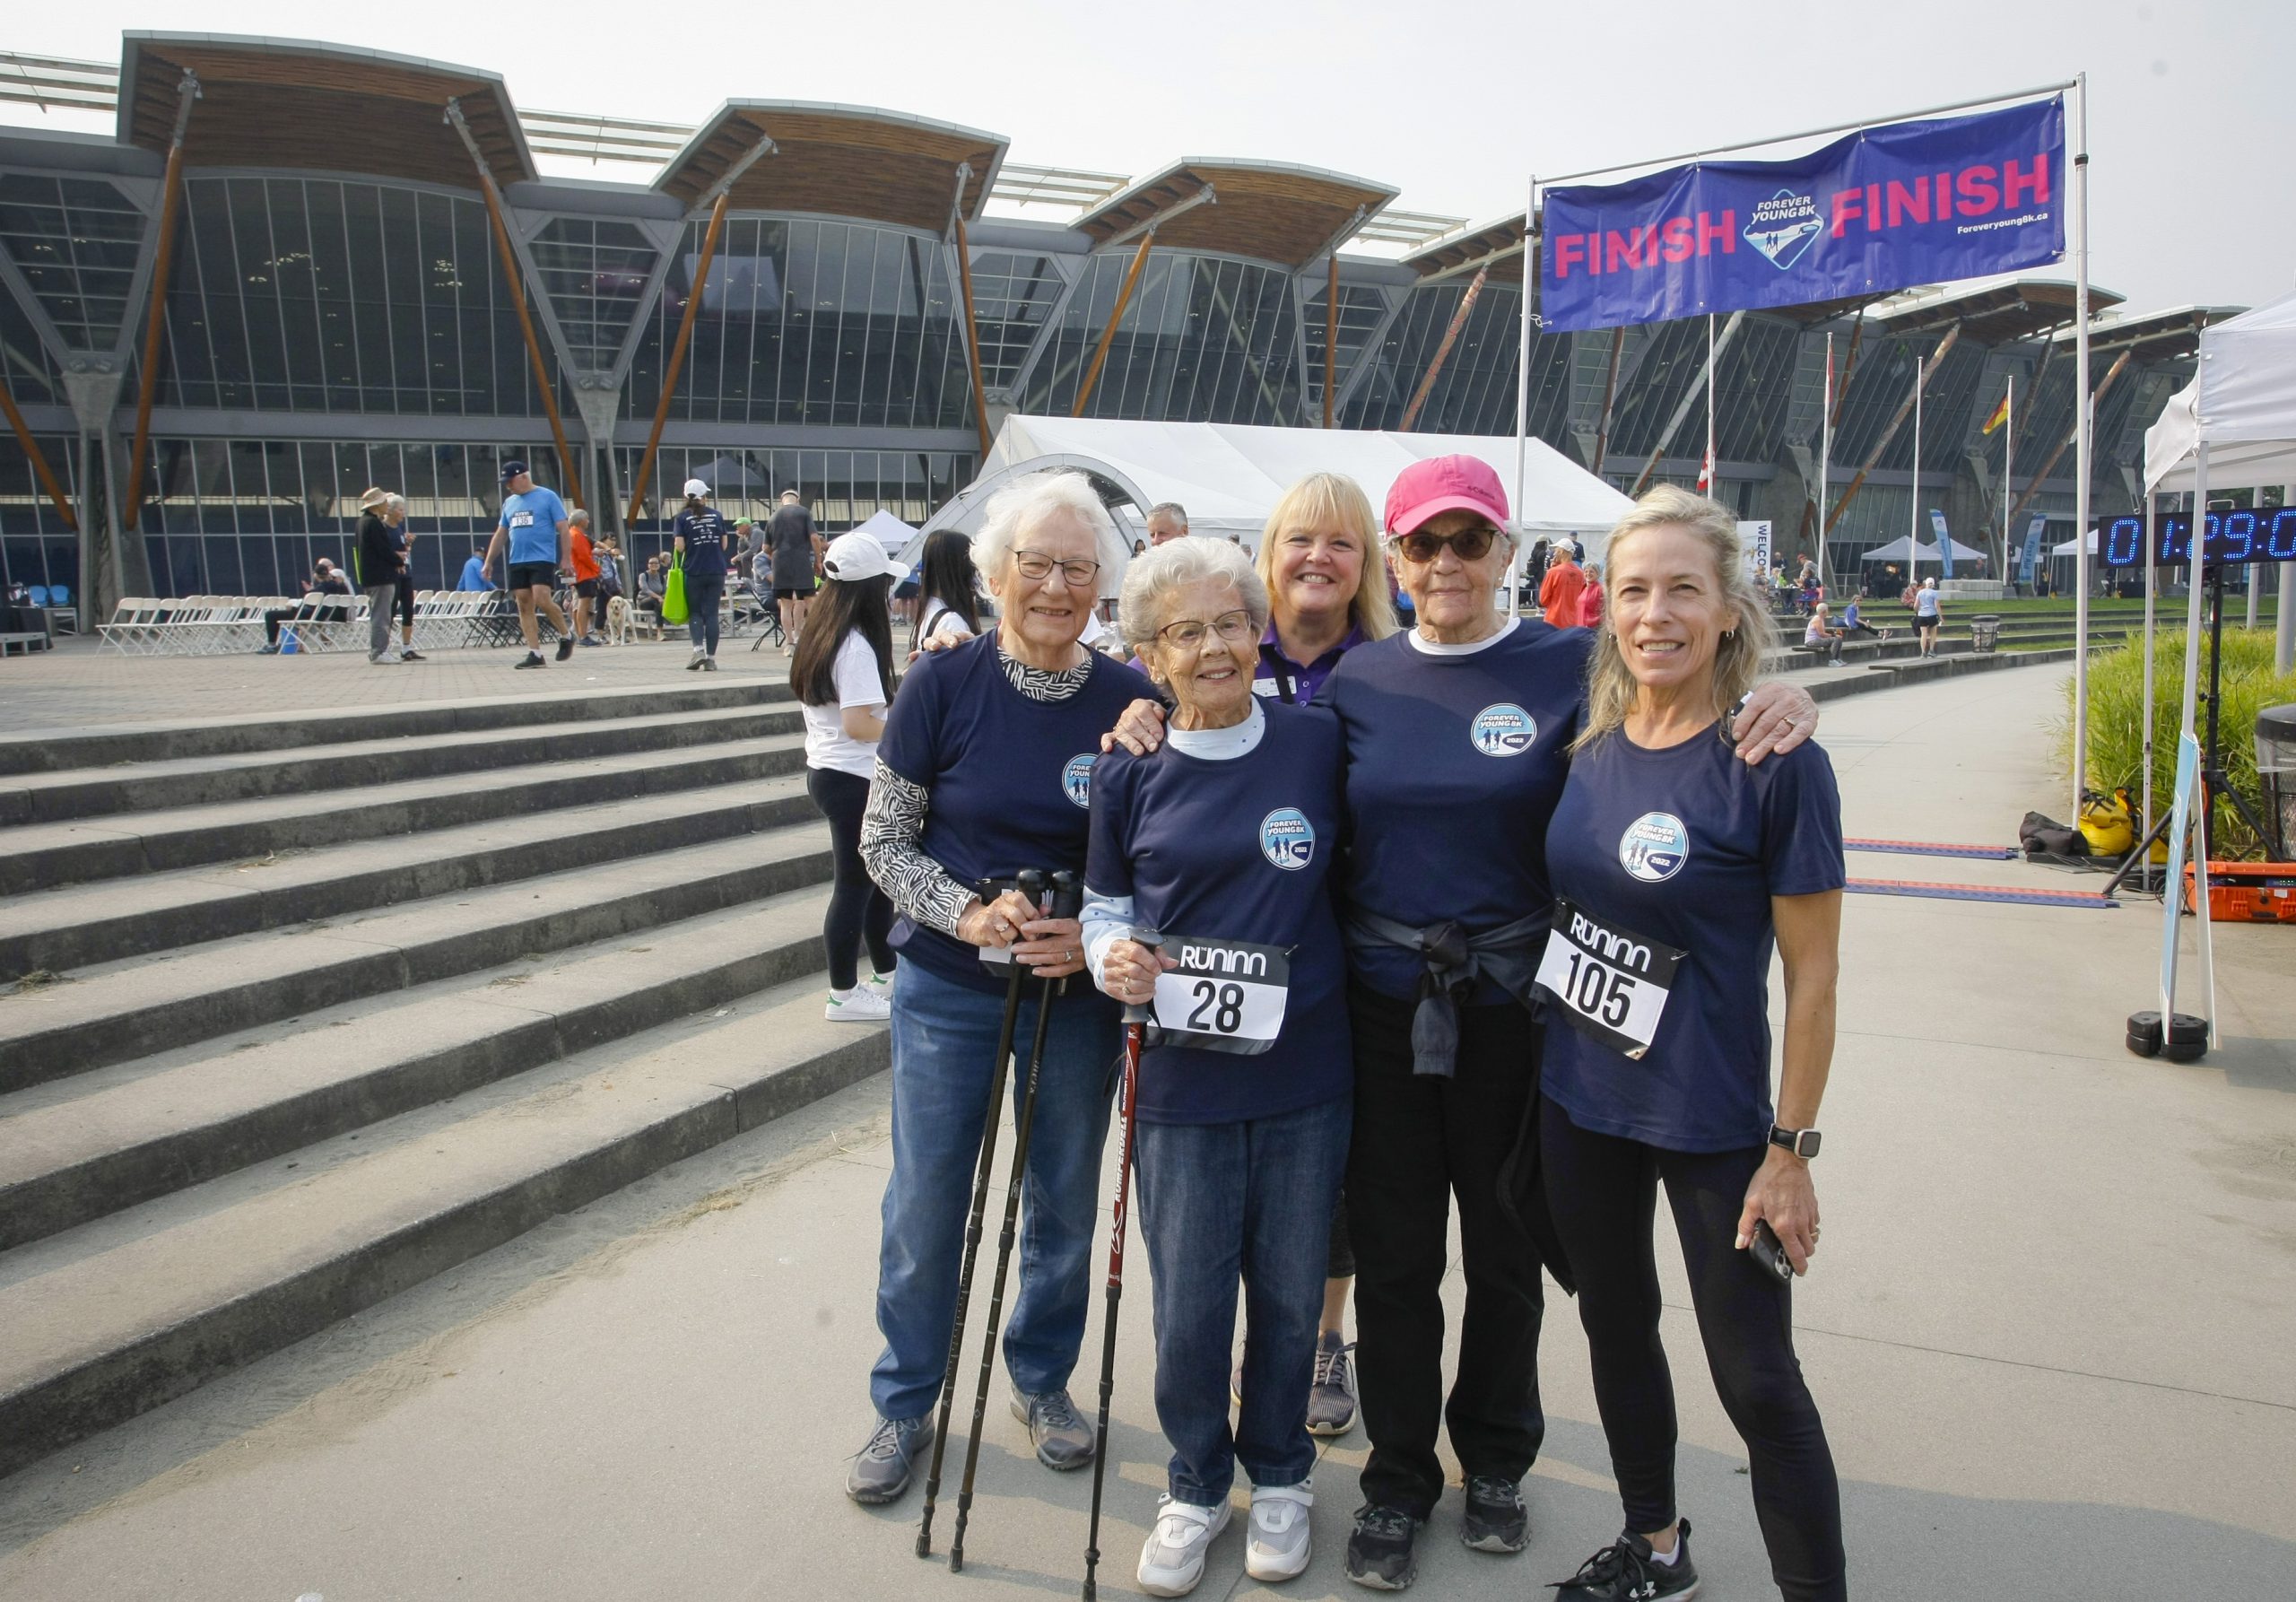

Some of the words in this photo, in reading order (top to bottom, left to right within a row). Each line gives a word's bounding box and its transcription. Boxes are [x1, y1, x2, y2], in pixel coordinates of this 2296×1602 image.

[1757, 196, 1811, 211] FOREVER
[1831, 152, 2049, 239] FINISH
[1957, 213, 2048, 234] Foreveryoung8k.ca
[1555, 209, 1735, 278] FINISH
[1758, 525, 1767, 566] WELCO
[1069, 770, 1091, 778] YOUN
[1270, 820, 1301, 828] FOREVER
[1638, 823, 1674, 836] FOREVER
[1187, 979, 1244, 1033] 28
[1565, 953, 1636, 1028] 105
